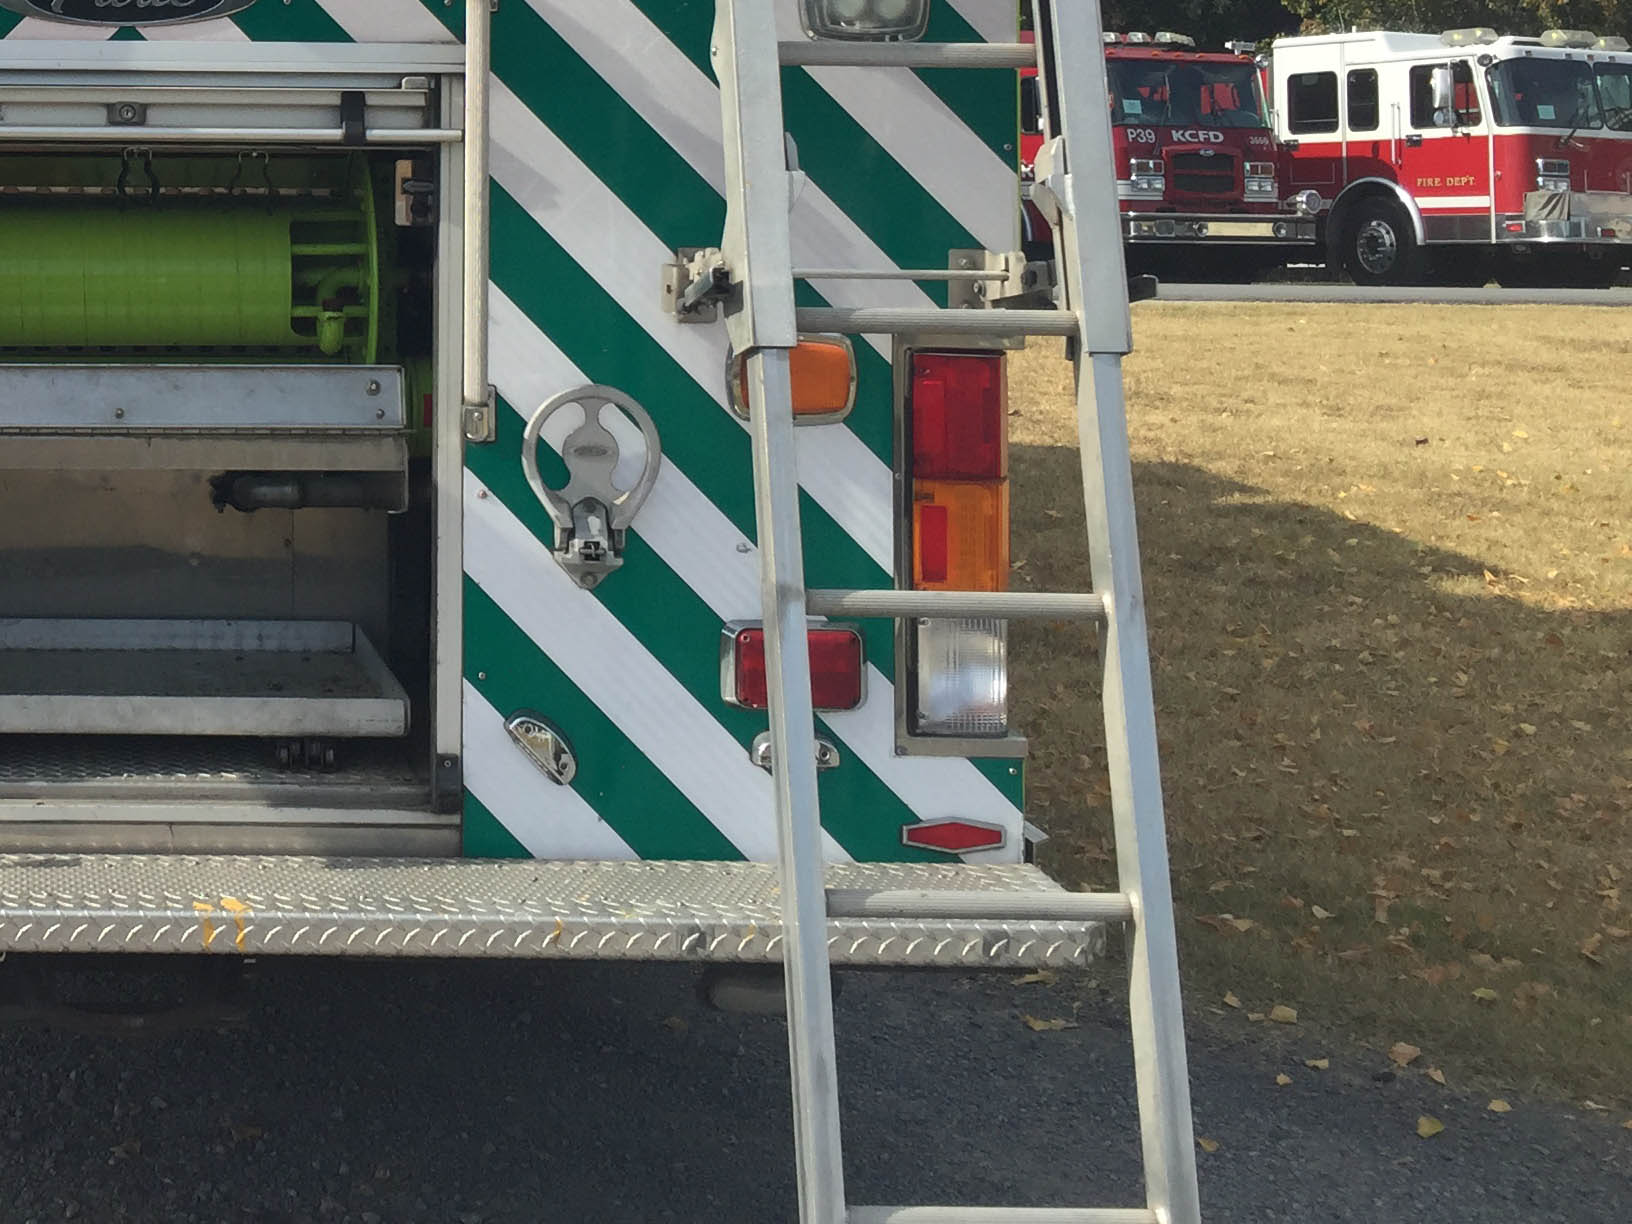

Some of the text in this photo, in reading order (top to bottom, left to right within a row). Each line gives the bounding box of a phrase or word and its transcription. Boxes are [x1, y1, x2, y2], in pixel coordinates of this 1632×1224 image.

[1127, 129, 1156, 143] P39
[1171, 130, 1224, 142] KCFD
[1417, 177, 1441, 187] FIRE
